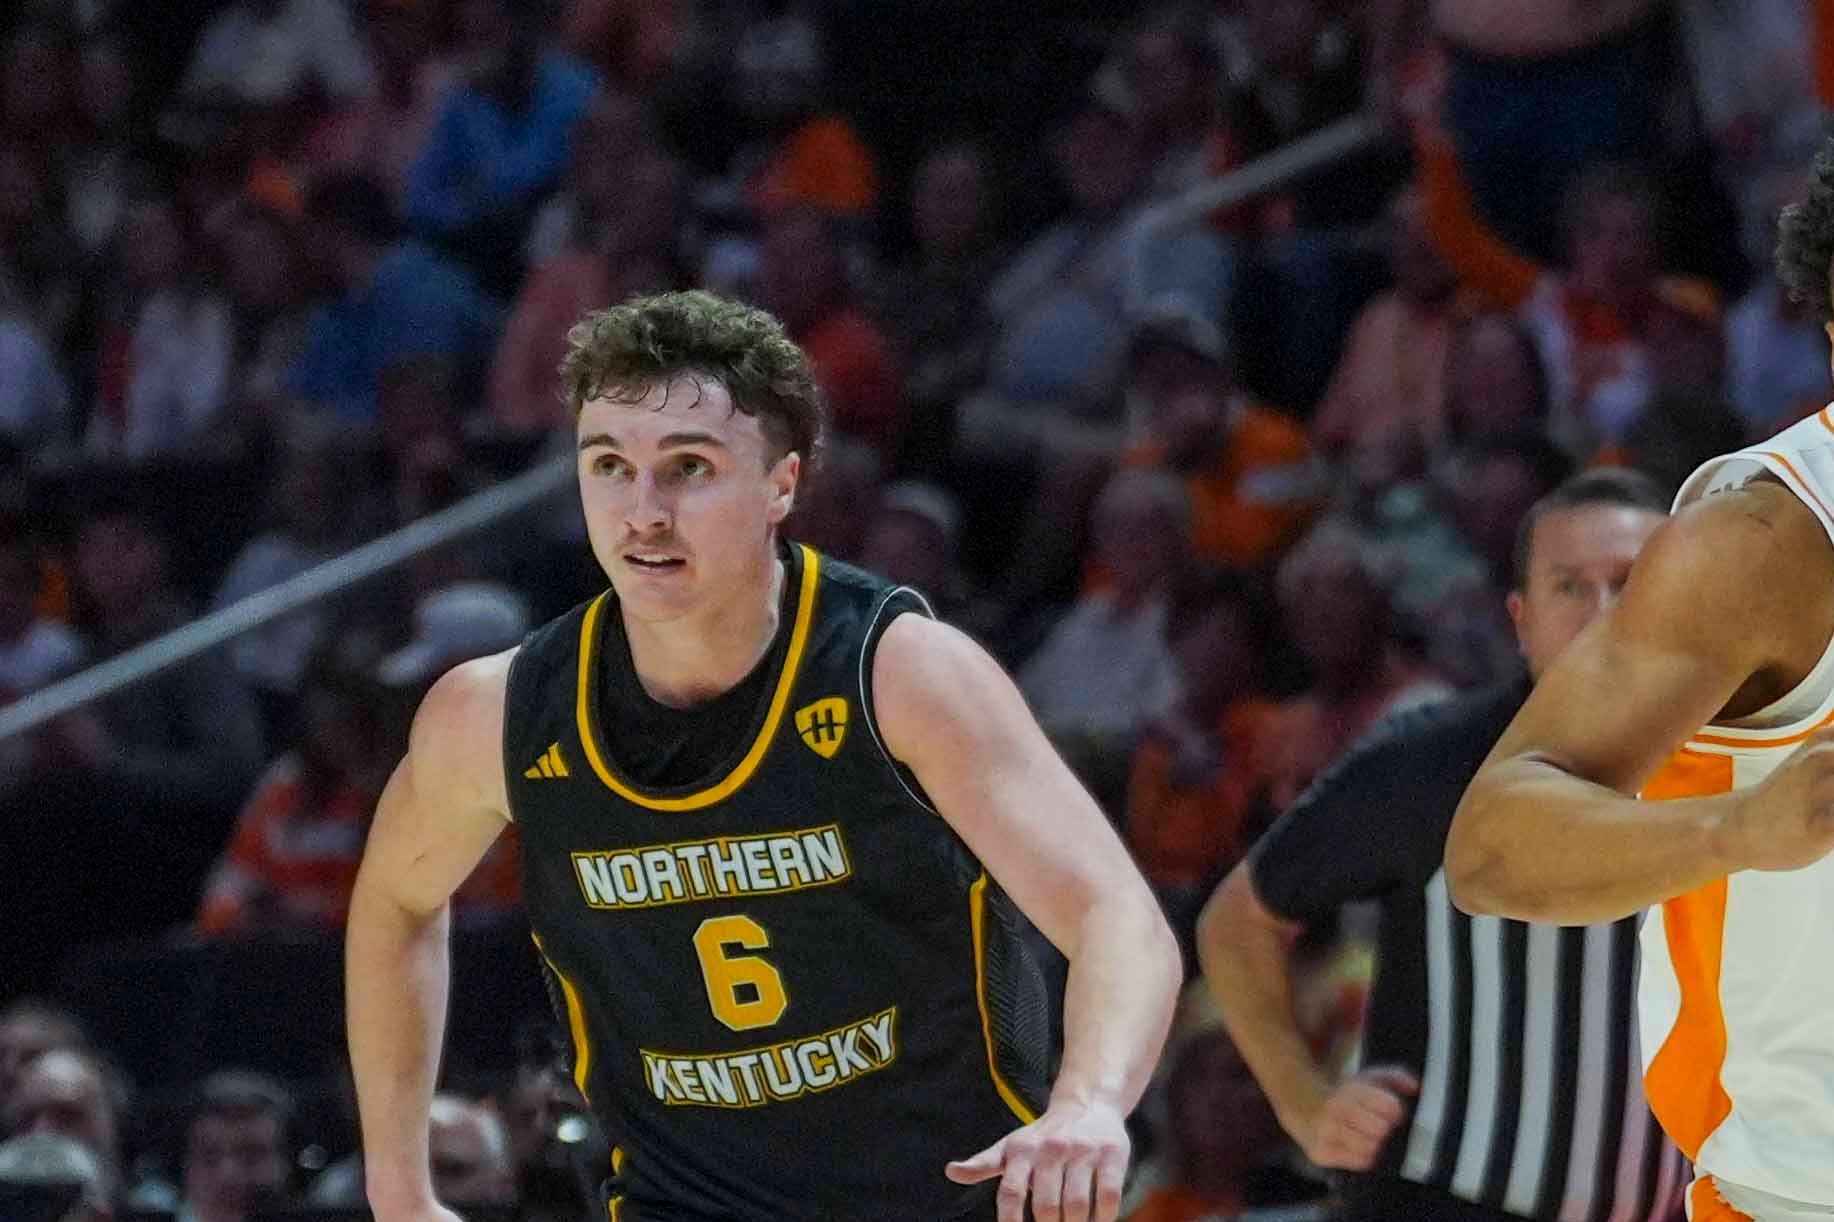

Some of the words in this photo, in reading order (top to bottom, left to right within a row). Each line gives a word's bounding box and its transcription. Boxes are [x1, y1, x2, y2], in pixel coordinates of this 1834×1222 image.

[572, 826, 850, 908] NORTHERN
[693, 915, 787, 1031] 6
[642, 1008, 895, 1107] KENTUCKY
